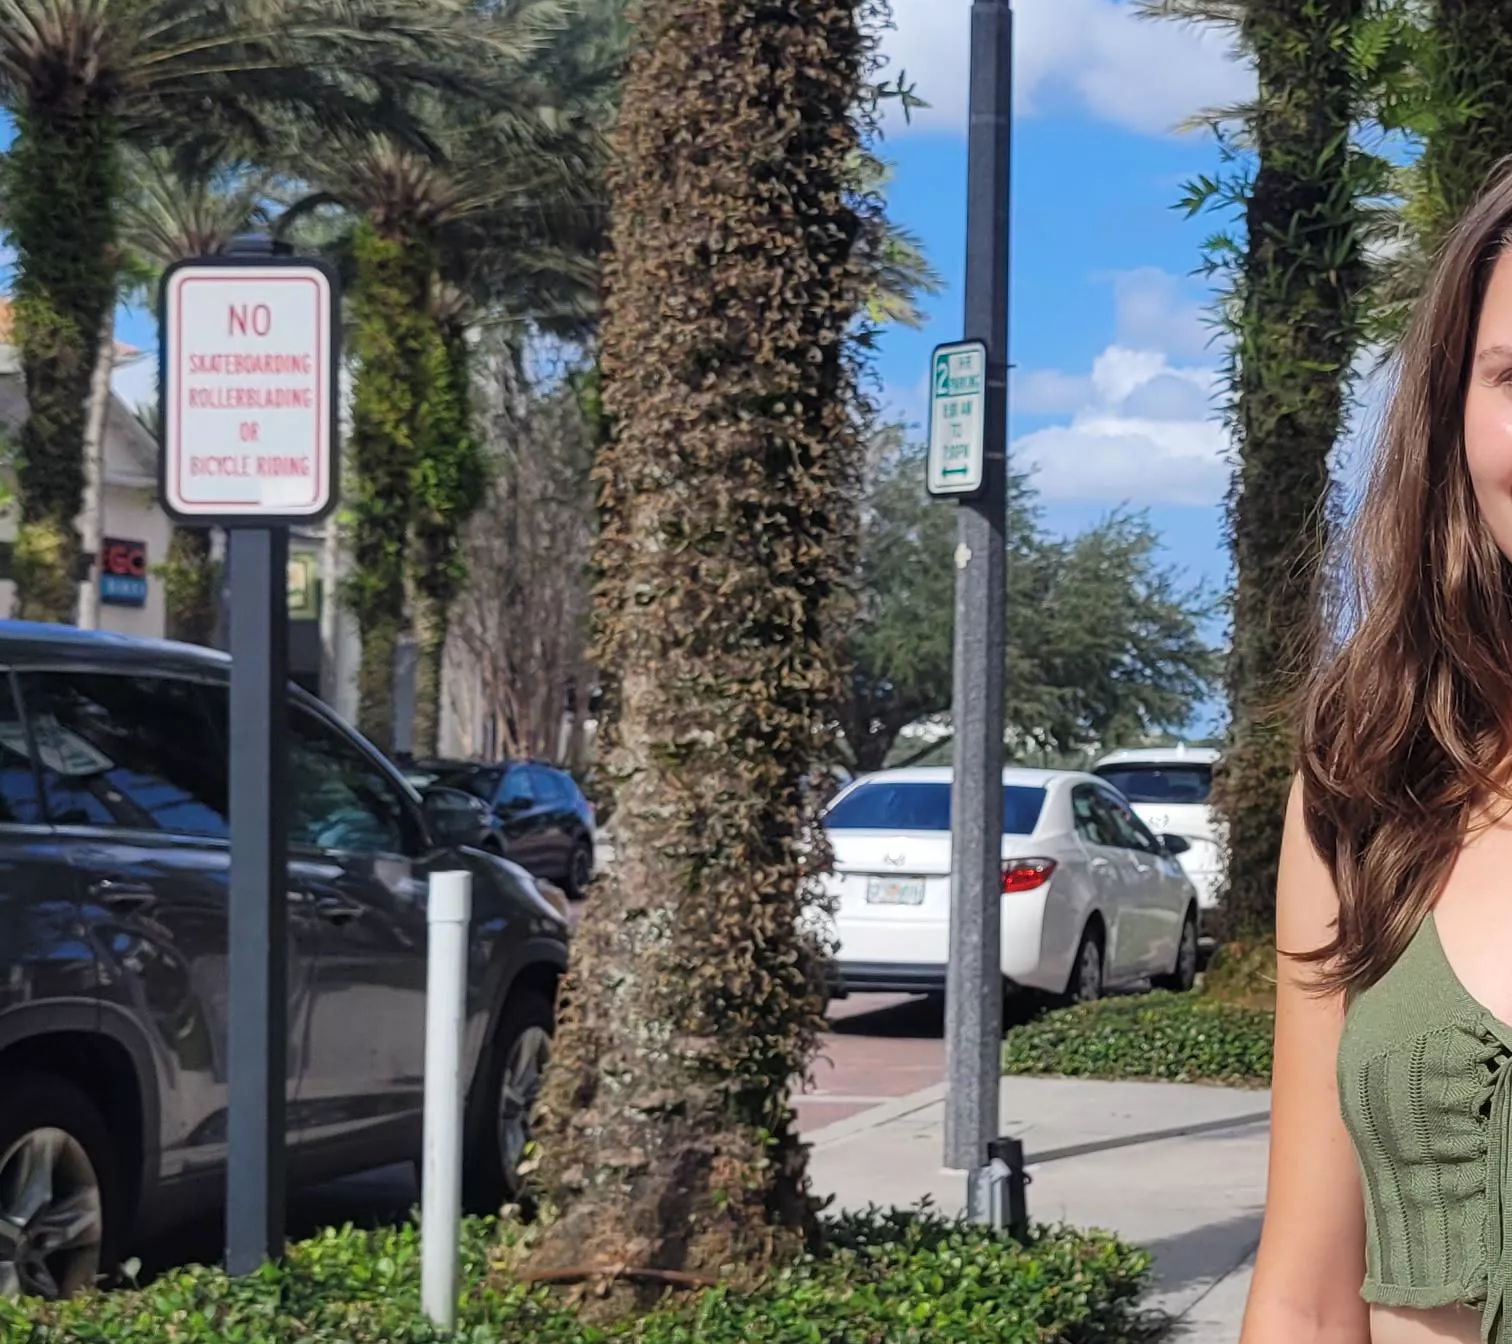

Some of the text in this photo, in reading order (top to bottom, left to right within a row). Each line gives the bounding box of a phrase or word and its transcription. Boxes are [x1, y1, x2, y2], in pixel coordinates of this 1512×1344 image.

[228, 304, 272, 336] NO
[188, 353, 312, 375] SKATEBOARDING
[936, 361, 948, 392] 2
[188, 388, 313, 409] ROLLERBLADING
[239, 421, 261, 443] OR
[190, 456, 310, 477] BICYCLE RIDING
